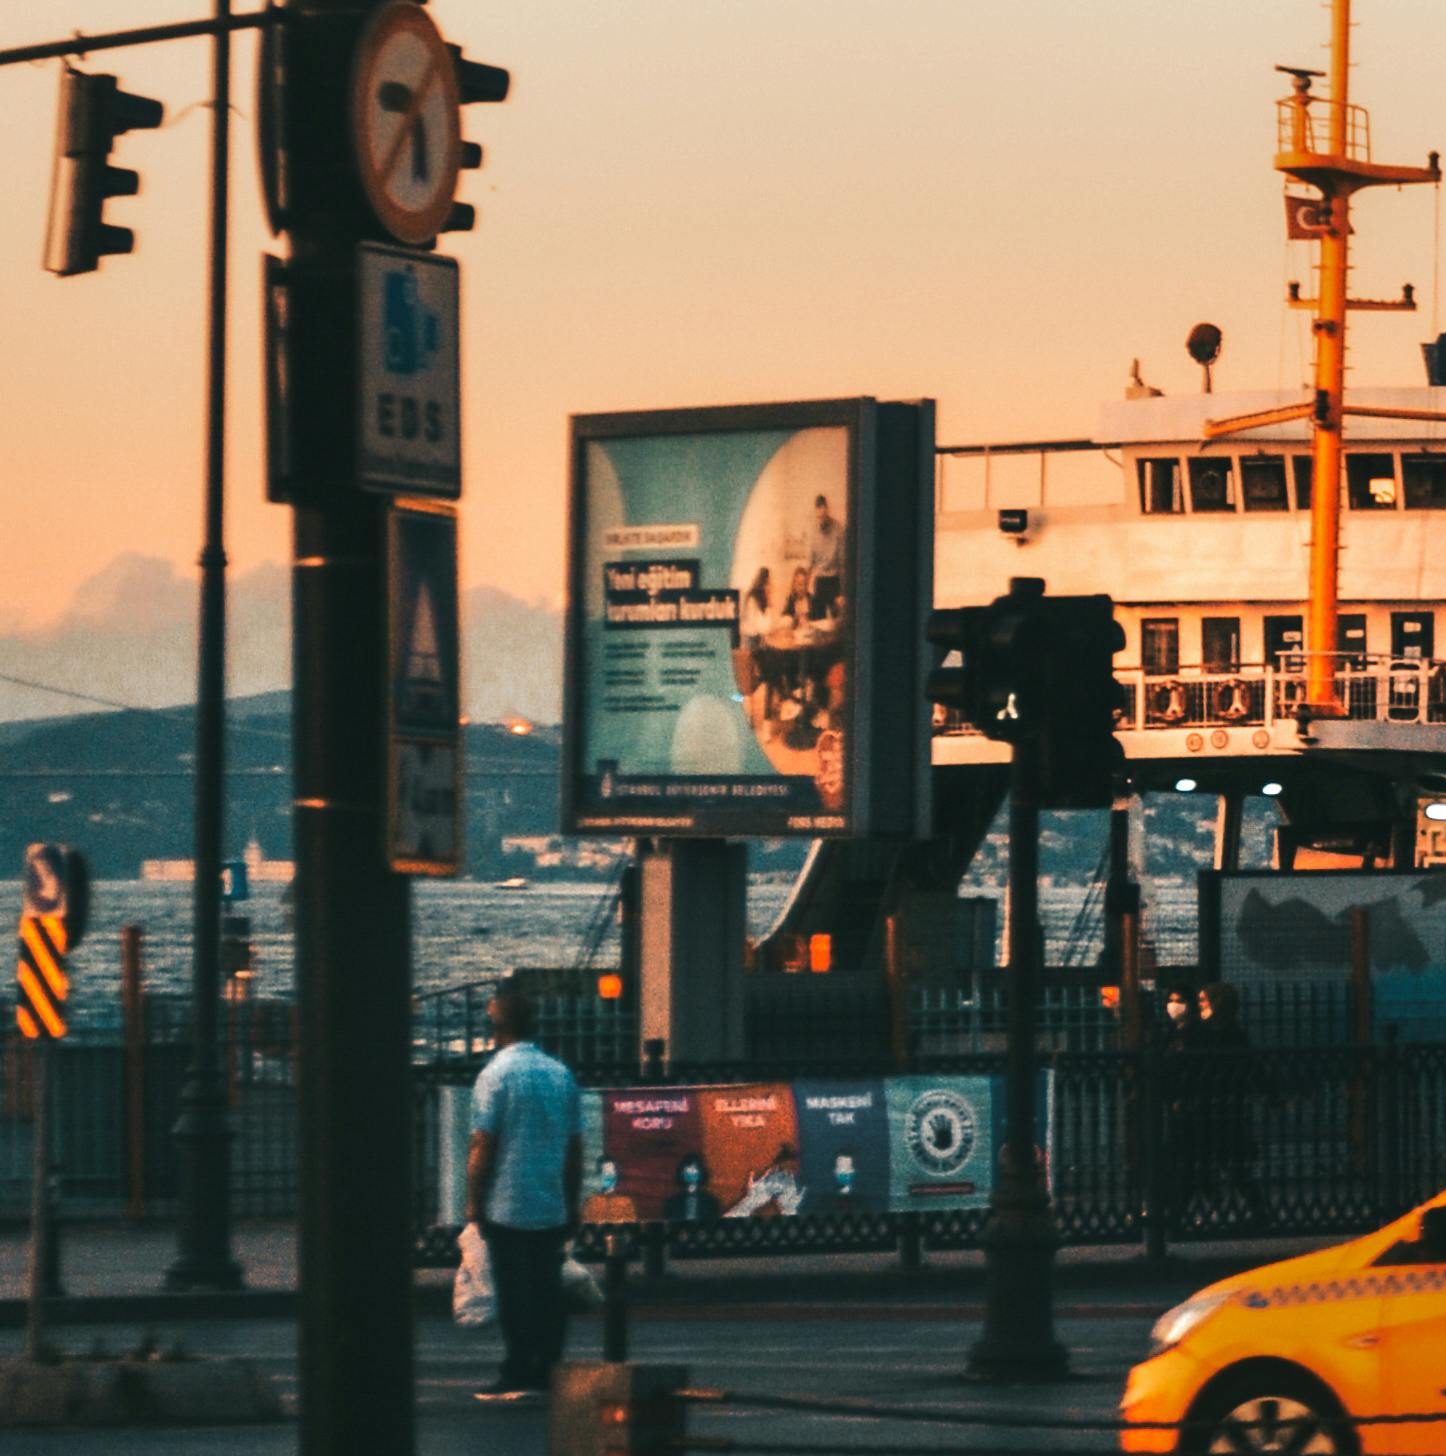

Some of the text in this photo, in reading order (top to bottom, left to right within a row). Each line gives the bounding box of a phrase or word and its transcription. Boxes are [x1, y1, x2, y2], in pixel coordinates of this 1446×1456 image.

[607, 564, 691, 597] Yeni eğitim
[827, 1111, 856, 1126] TAK
